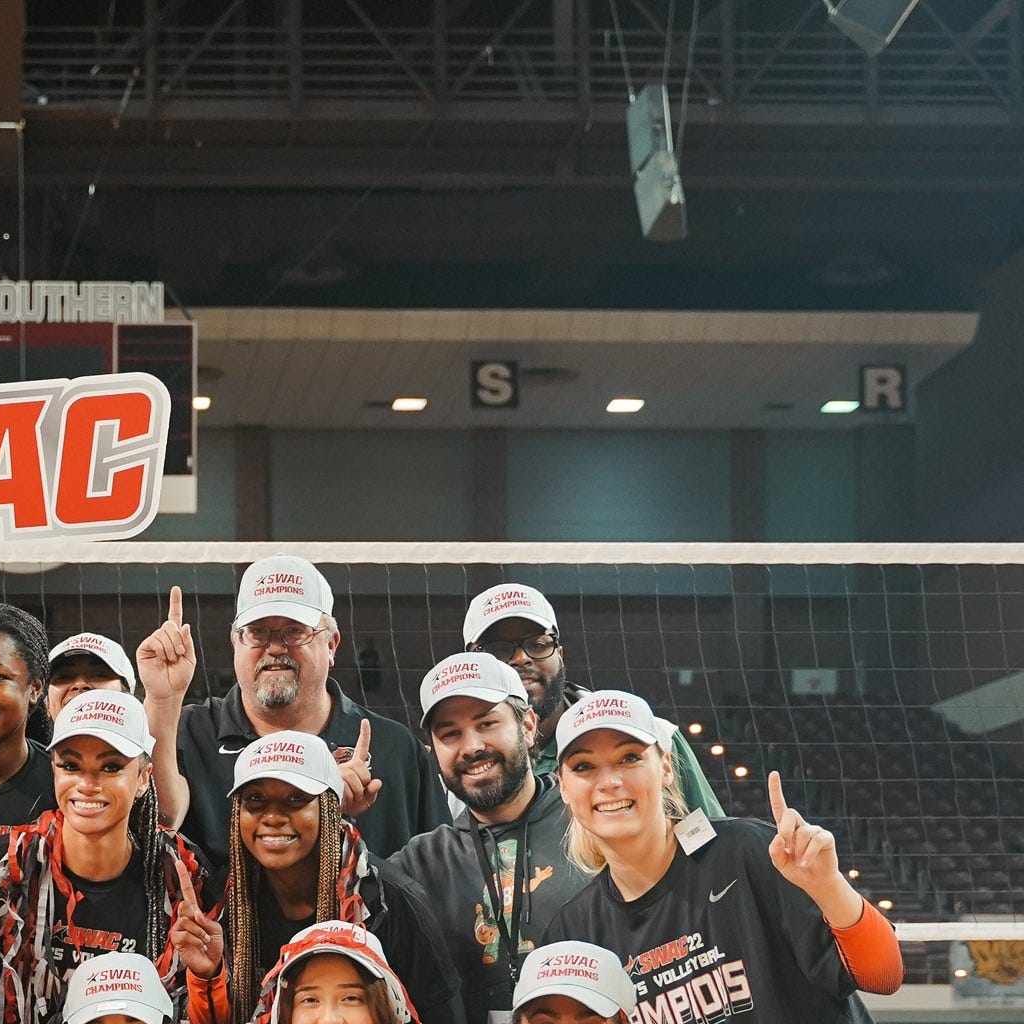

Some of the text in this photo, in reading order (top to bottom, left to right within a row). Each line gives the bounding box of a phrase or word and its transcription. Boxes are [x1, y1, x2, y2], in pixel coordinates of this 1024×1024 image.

[474, 363, 514, 406] S
[863, 367, 902, 408] R
[267, 573, 304, 586] SWAC
[254, 586, 305, 597] CHAMPIONS
[493, 590, 529, 604] SWAC
[483, 600, 532, 617] CHAMPIONS
[441, 662, 479, 679] SWAC
[431, 673, 482, 695] CHAMPIONS
[85, 701, 126, 716] SWAC
[586, 698, 629, 711] SWAC
[70, 714, 125, 727] CHAMPIONS
[573, 709, 632, 728] CHAMPIONS
[263, 742, 306, 756] SWAC
[249, 753, 306, 767] CHAMPIONS
[121, 938, 137, 953] 22
[638, 932, 704, 975] SWAC 22
[553, 955, 600, 970] SWAC
[99, 969, 141, 982] SWAC
[537, 969, 600, 983] CHAMPIONS
[85, 982, 143, 996] CHAMPIONS
